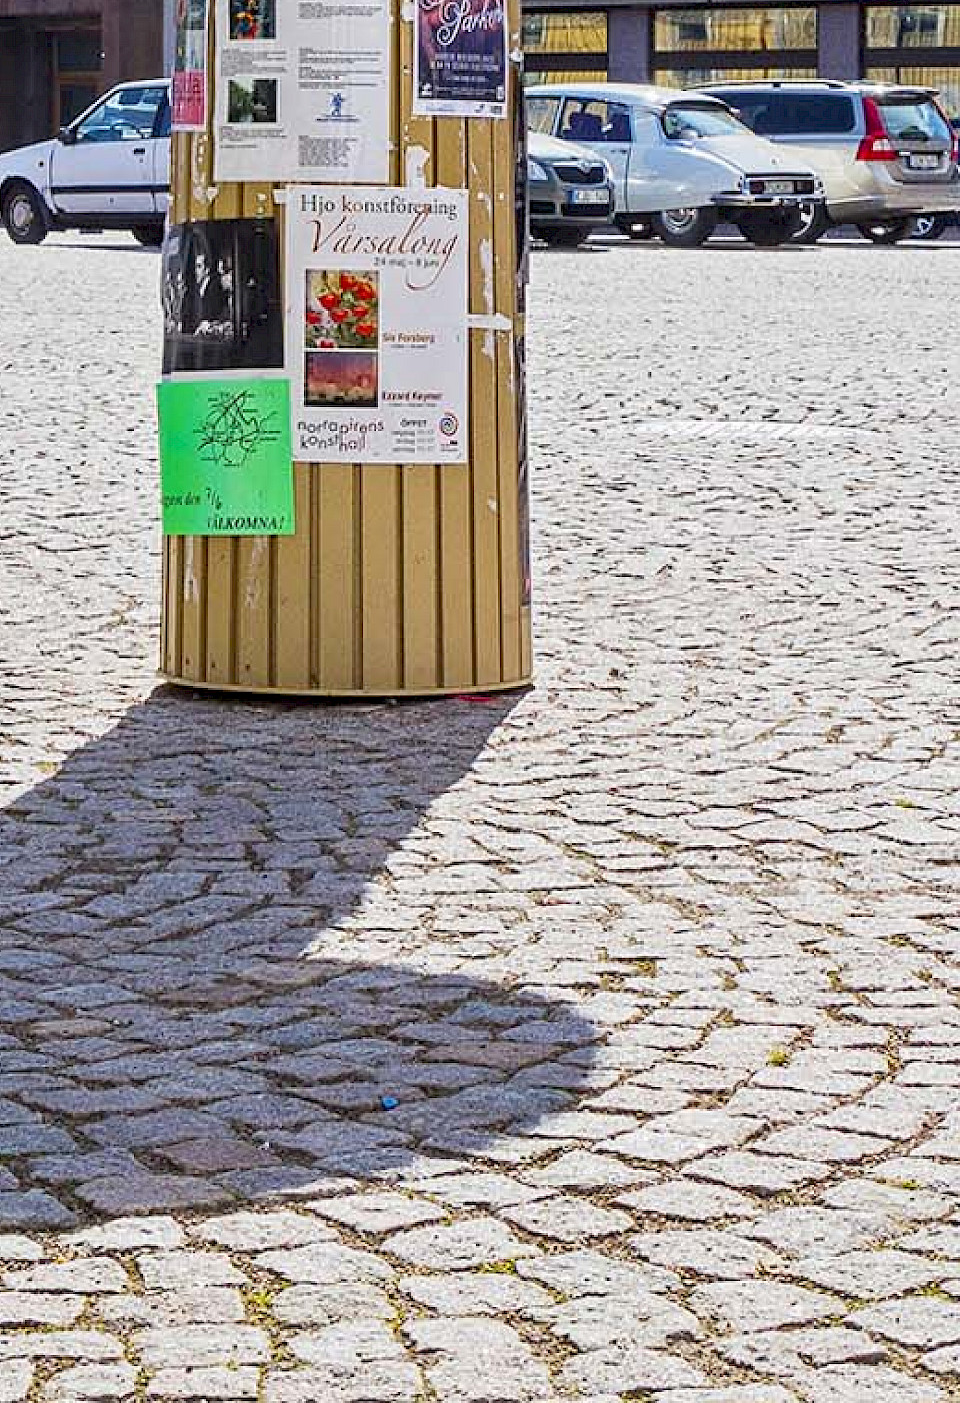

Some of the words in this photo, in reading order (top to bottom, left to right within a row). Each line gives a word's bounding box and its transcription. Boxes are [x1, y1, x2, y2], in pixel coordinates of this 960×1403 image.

[300, 194, 336, 215] Hjo
[341, 195, 458, 220] konstförening
[306, 205, 458, 276] Vårsalong
